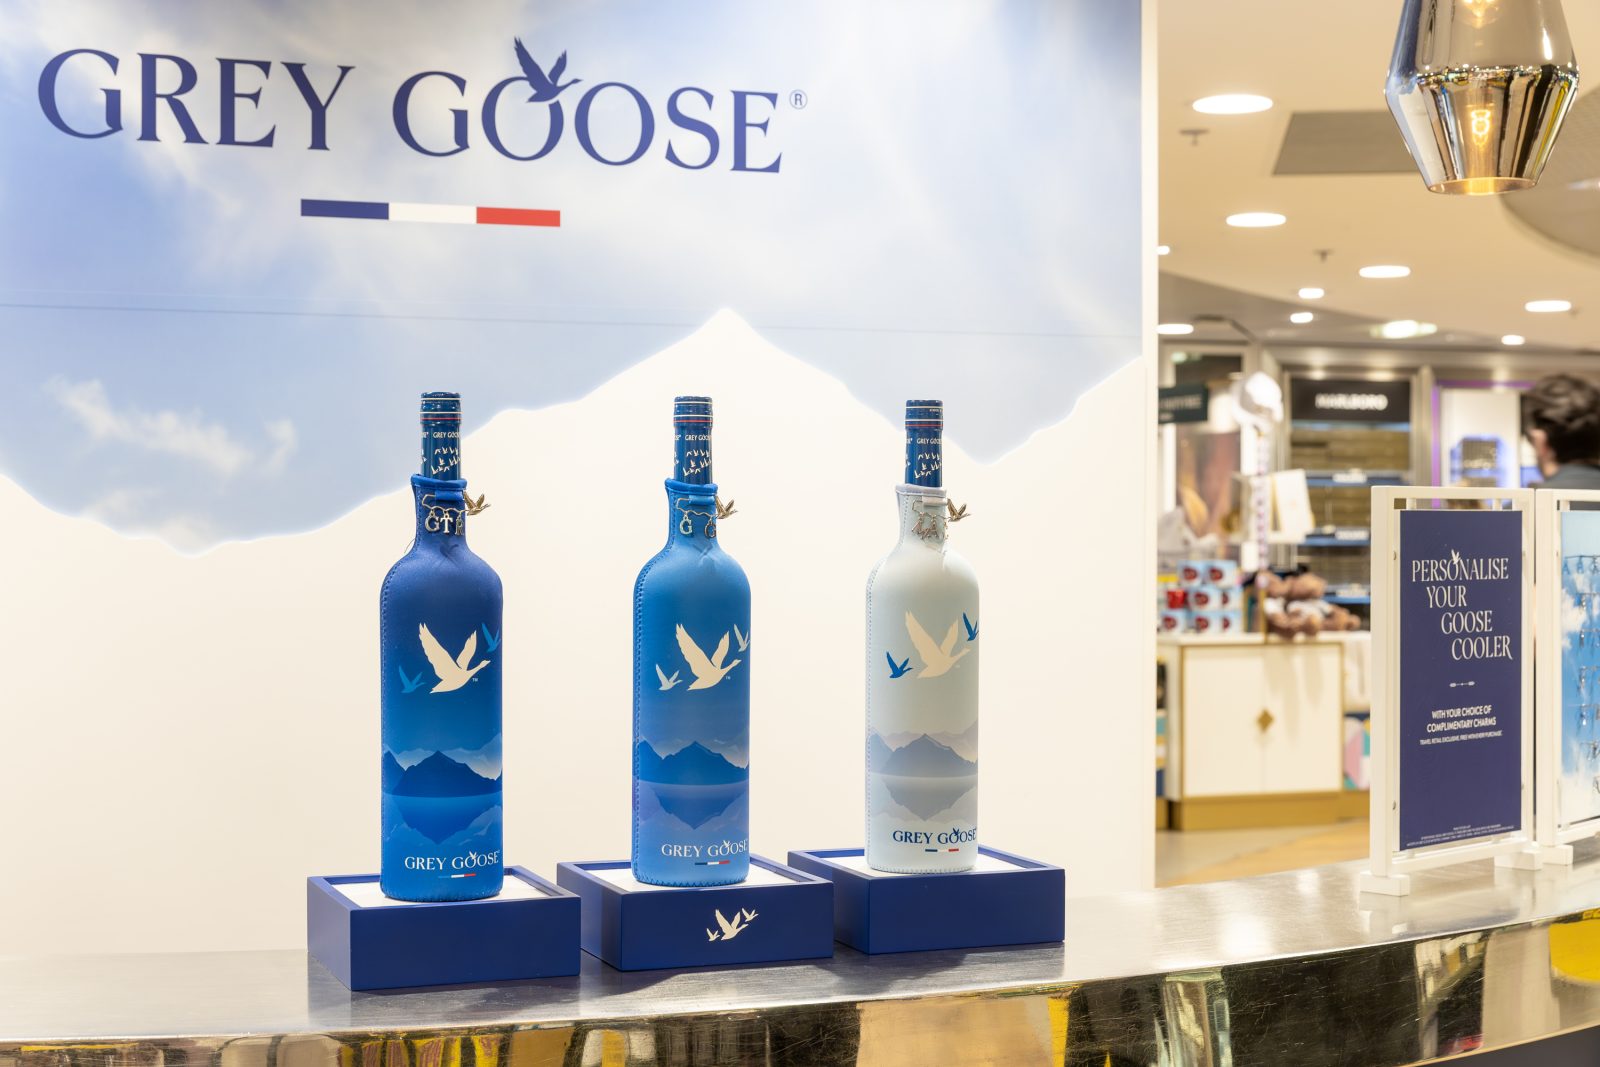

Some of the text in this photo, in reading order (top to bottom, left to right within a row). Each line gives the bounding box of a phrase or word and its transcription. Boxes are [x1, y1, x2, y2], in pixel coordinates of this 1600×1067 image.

[38, 49, 355, 151] GREY
[393, 70, 781, 174] GOOSE
[1411, 557, 1510, 583] PERSONALISE
[1426, 586, 1467, 609] YOUR
[1441, 610, 1493, 635] GOOSE
[1451, 635, 1513, 660] COOLER
[1431, 704, 1492, 719] WITH YOUR CHOICE OF
[1426, 716, 1497, 733] COMPLIMENTARY CHARMS
[892, 828, 977, 845] GREY GOOSE
[661, 840, 747, 858] GREY GOOSE
[404, 852, 499, 870] GREY GOOSE
